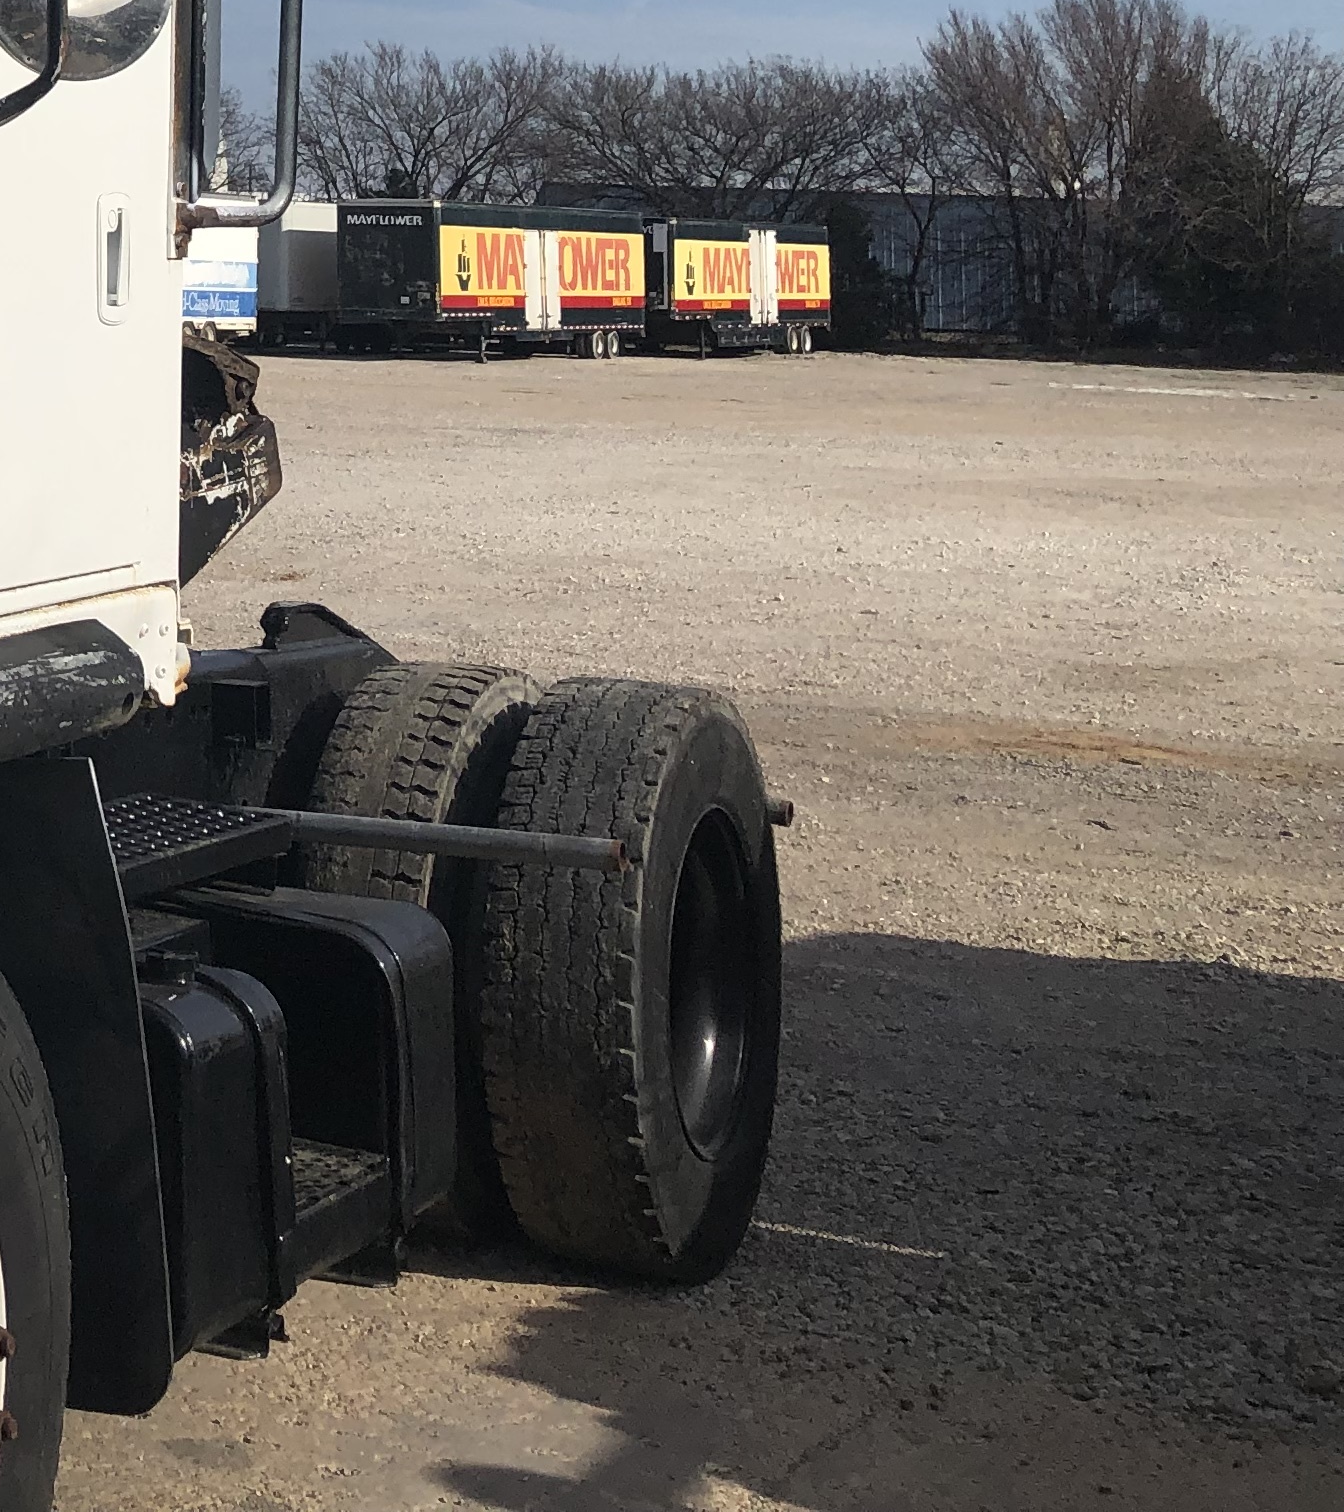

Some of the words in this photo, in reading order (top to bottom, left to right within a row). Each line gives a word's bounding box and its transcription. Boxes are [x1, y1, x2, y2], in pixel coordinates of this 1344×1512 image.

[346, 213, 423, 226] MAYFLOWER
[702, 247, 820, 294] MAYWER
[209, 292, 240, 316] Moving
